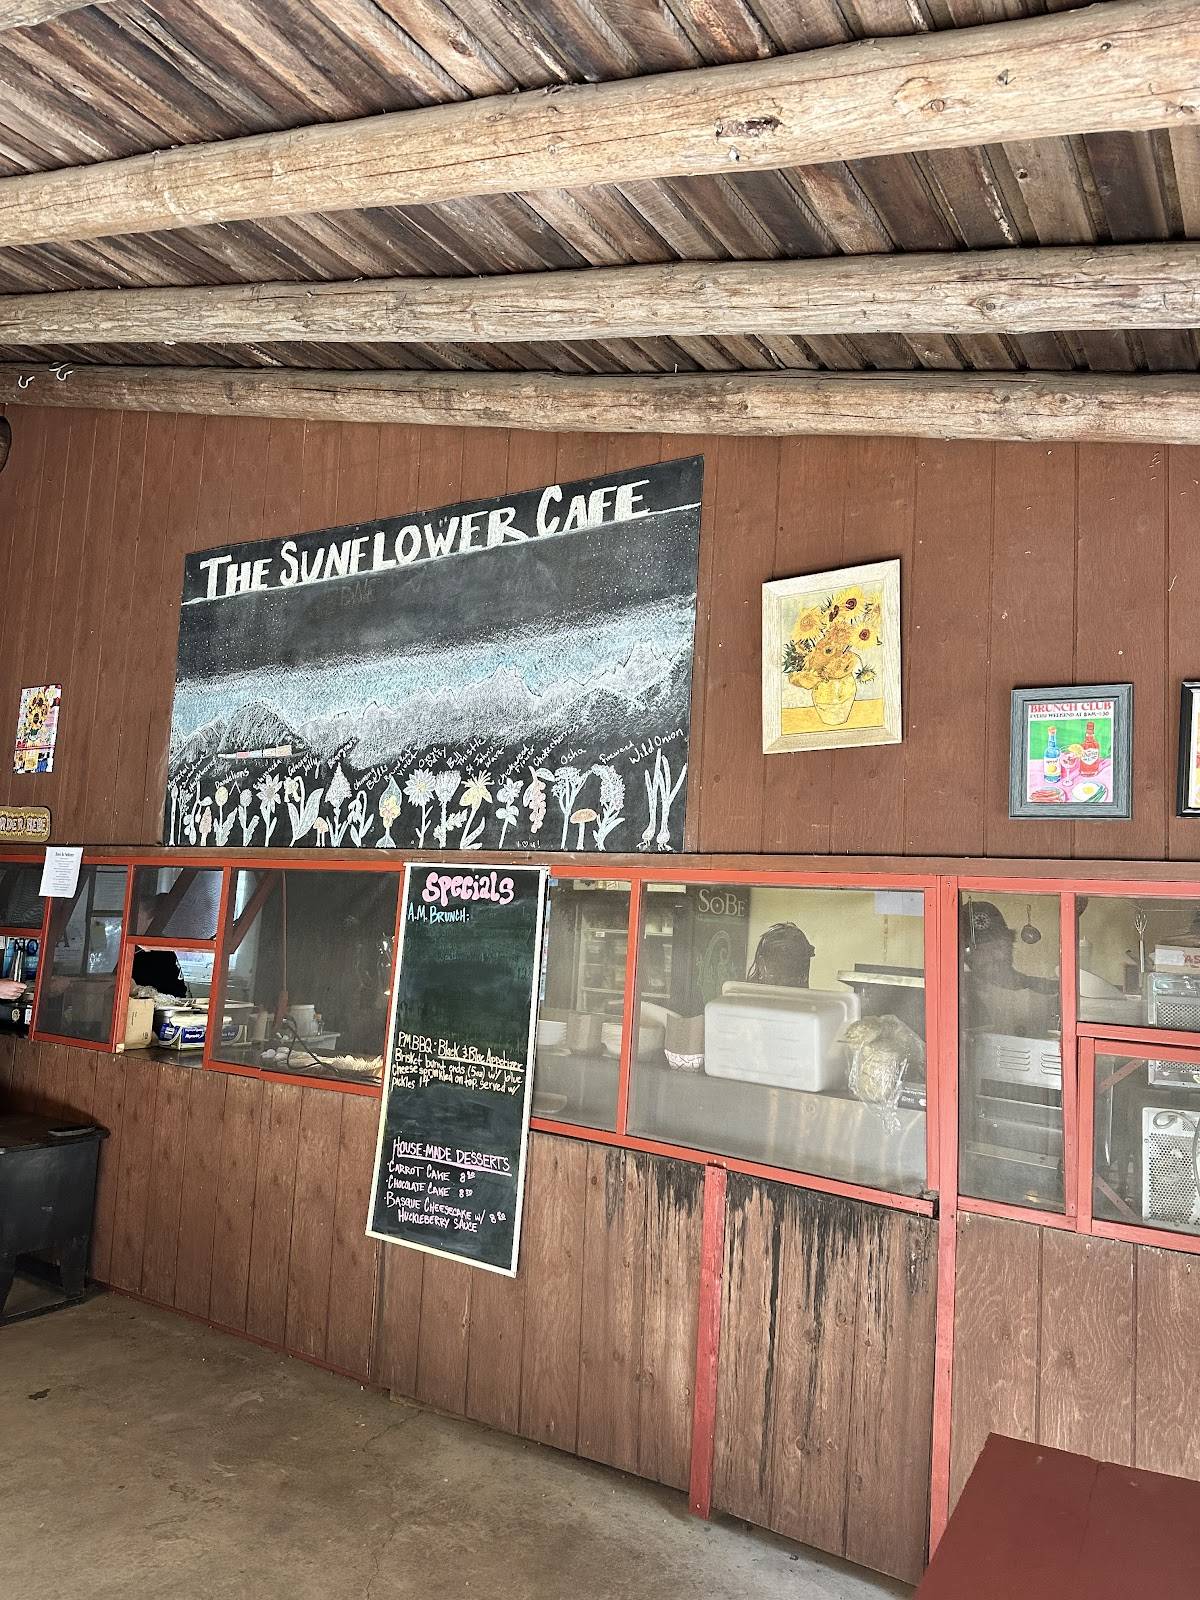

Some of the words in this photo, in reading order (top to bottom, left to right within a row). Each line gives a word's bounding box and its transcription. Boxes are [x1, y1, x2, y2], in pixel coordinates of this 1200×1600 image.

[200, 555, 273, 599] THE
[280, 507, 529, 586] SUNFLOWER
[537, 479, 650, 536] CAFE
[1030, 703, 1077, 713] BRUNCH
[1081, 701, 1111, 711] CLUB
[457, 738, 487, 765] Thistle
[560, 748, 587, 764] Osha
[629, 738, 654, 764] Wild
[654, 727, 684, 748] Onion
[446, 751, 462, 769] Bull
[215, 767, 250, 789] Dandelions
[422, 871, 514, 907] Specials
[407, 902, 428, 922] A.M.
[429, 905, 470, 924] BRUNCH:
[395, 1047, 423, 1066] Brisket
[488, 1070, 502, 1081] w/
[504, 1070, 523, 1084] blue
[454, 1075, 464, 1085] on
[508, 1084, 520, 1096] w/
[393, 1136, 451, 1162] HOUSE-MADE
[456, 1149, 510, 1171] DESSERTS
[389, 1160, 424, 1177] CARROT
[426, 1164, 450, 1181] CAKE
[388, 1174, 426, 1192] CHOCOLATE
[427, 1182, 450, 1197] CAKE
[386, 1191, 421, 1210] BASQUE
[424, 1197, 472, 1220] CHEESECAKE
[474, 1209, 485, 1225] w/
[398, 1207, 450, 1229] HUCKLEBERRY
[454, 1218, 478, 1233] SAUCE
